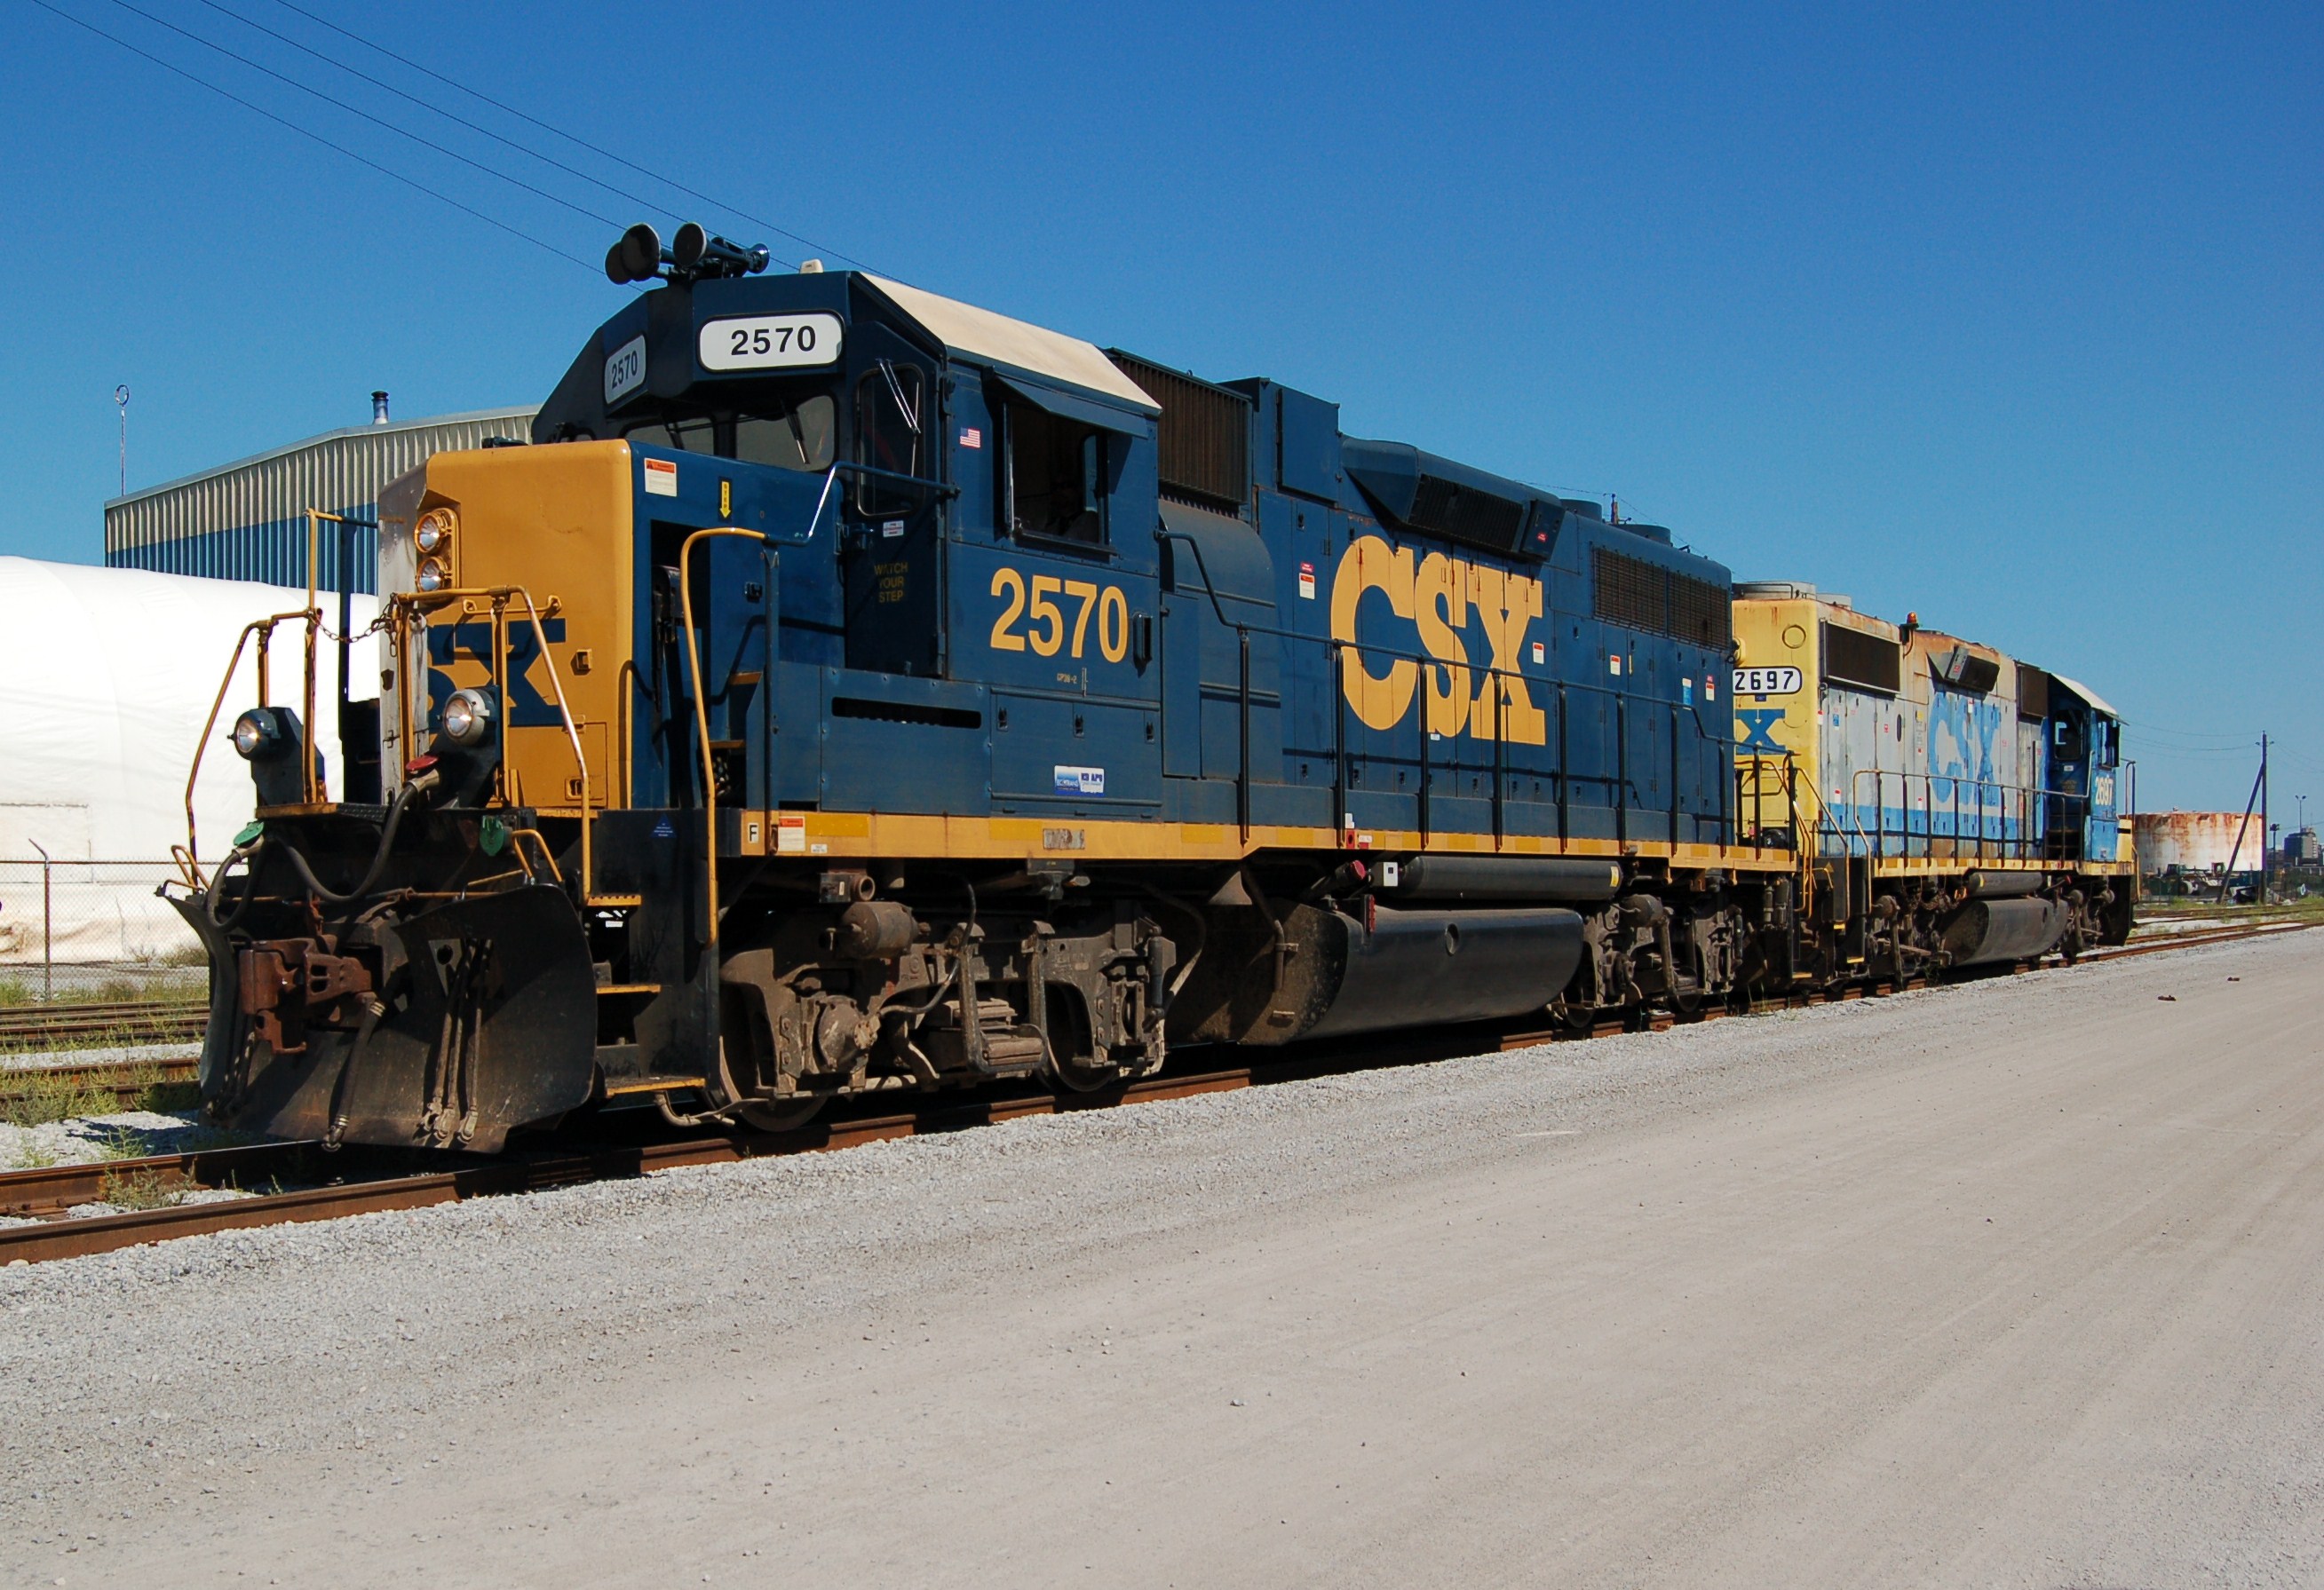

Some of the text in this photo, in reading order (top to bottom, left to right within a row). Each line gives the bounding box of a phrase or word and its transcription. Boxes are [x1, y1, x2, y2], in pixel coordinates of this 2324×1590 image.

[730, 325, 817, 356] 2570
[610, 350, 639, 390] 2570
[874, 562, 908, 575] WATCH
[878, 575, 905, 589] YOUR
[878, 589, 904, 603] STEP
[989, 567, 1129, 664] 2570
[1330, 534, 1546, 746] CSX
[1734, 670, 1794, 691] 2697
[1927, 691, 2000, 806] CSX
[2095, 776, 2114, 806] 2697
[749, 824, 758, 842] F
